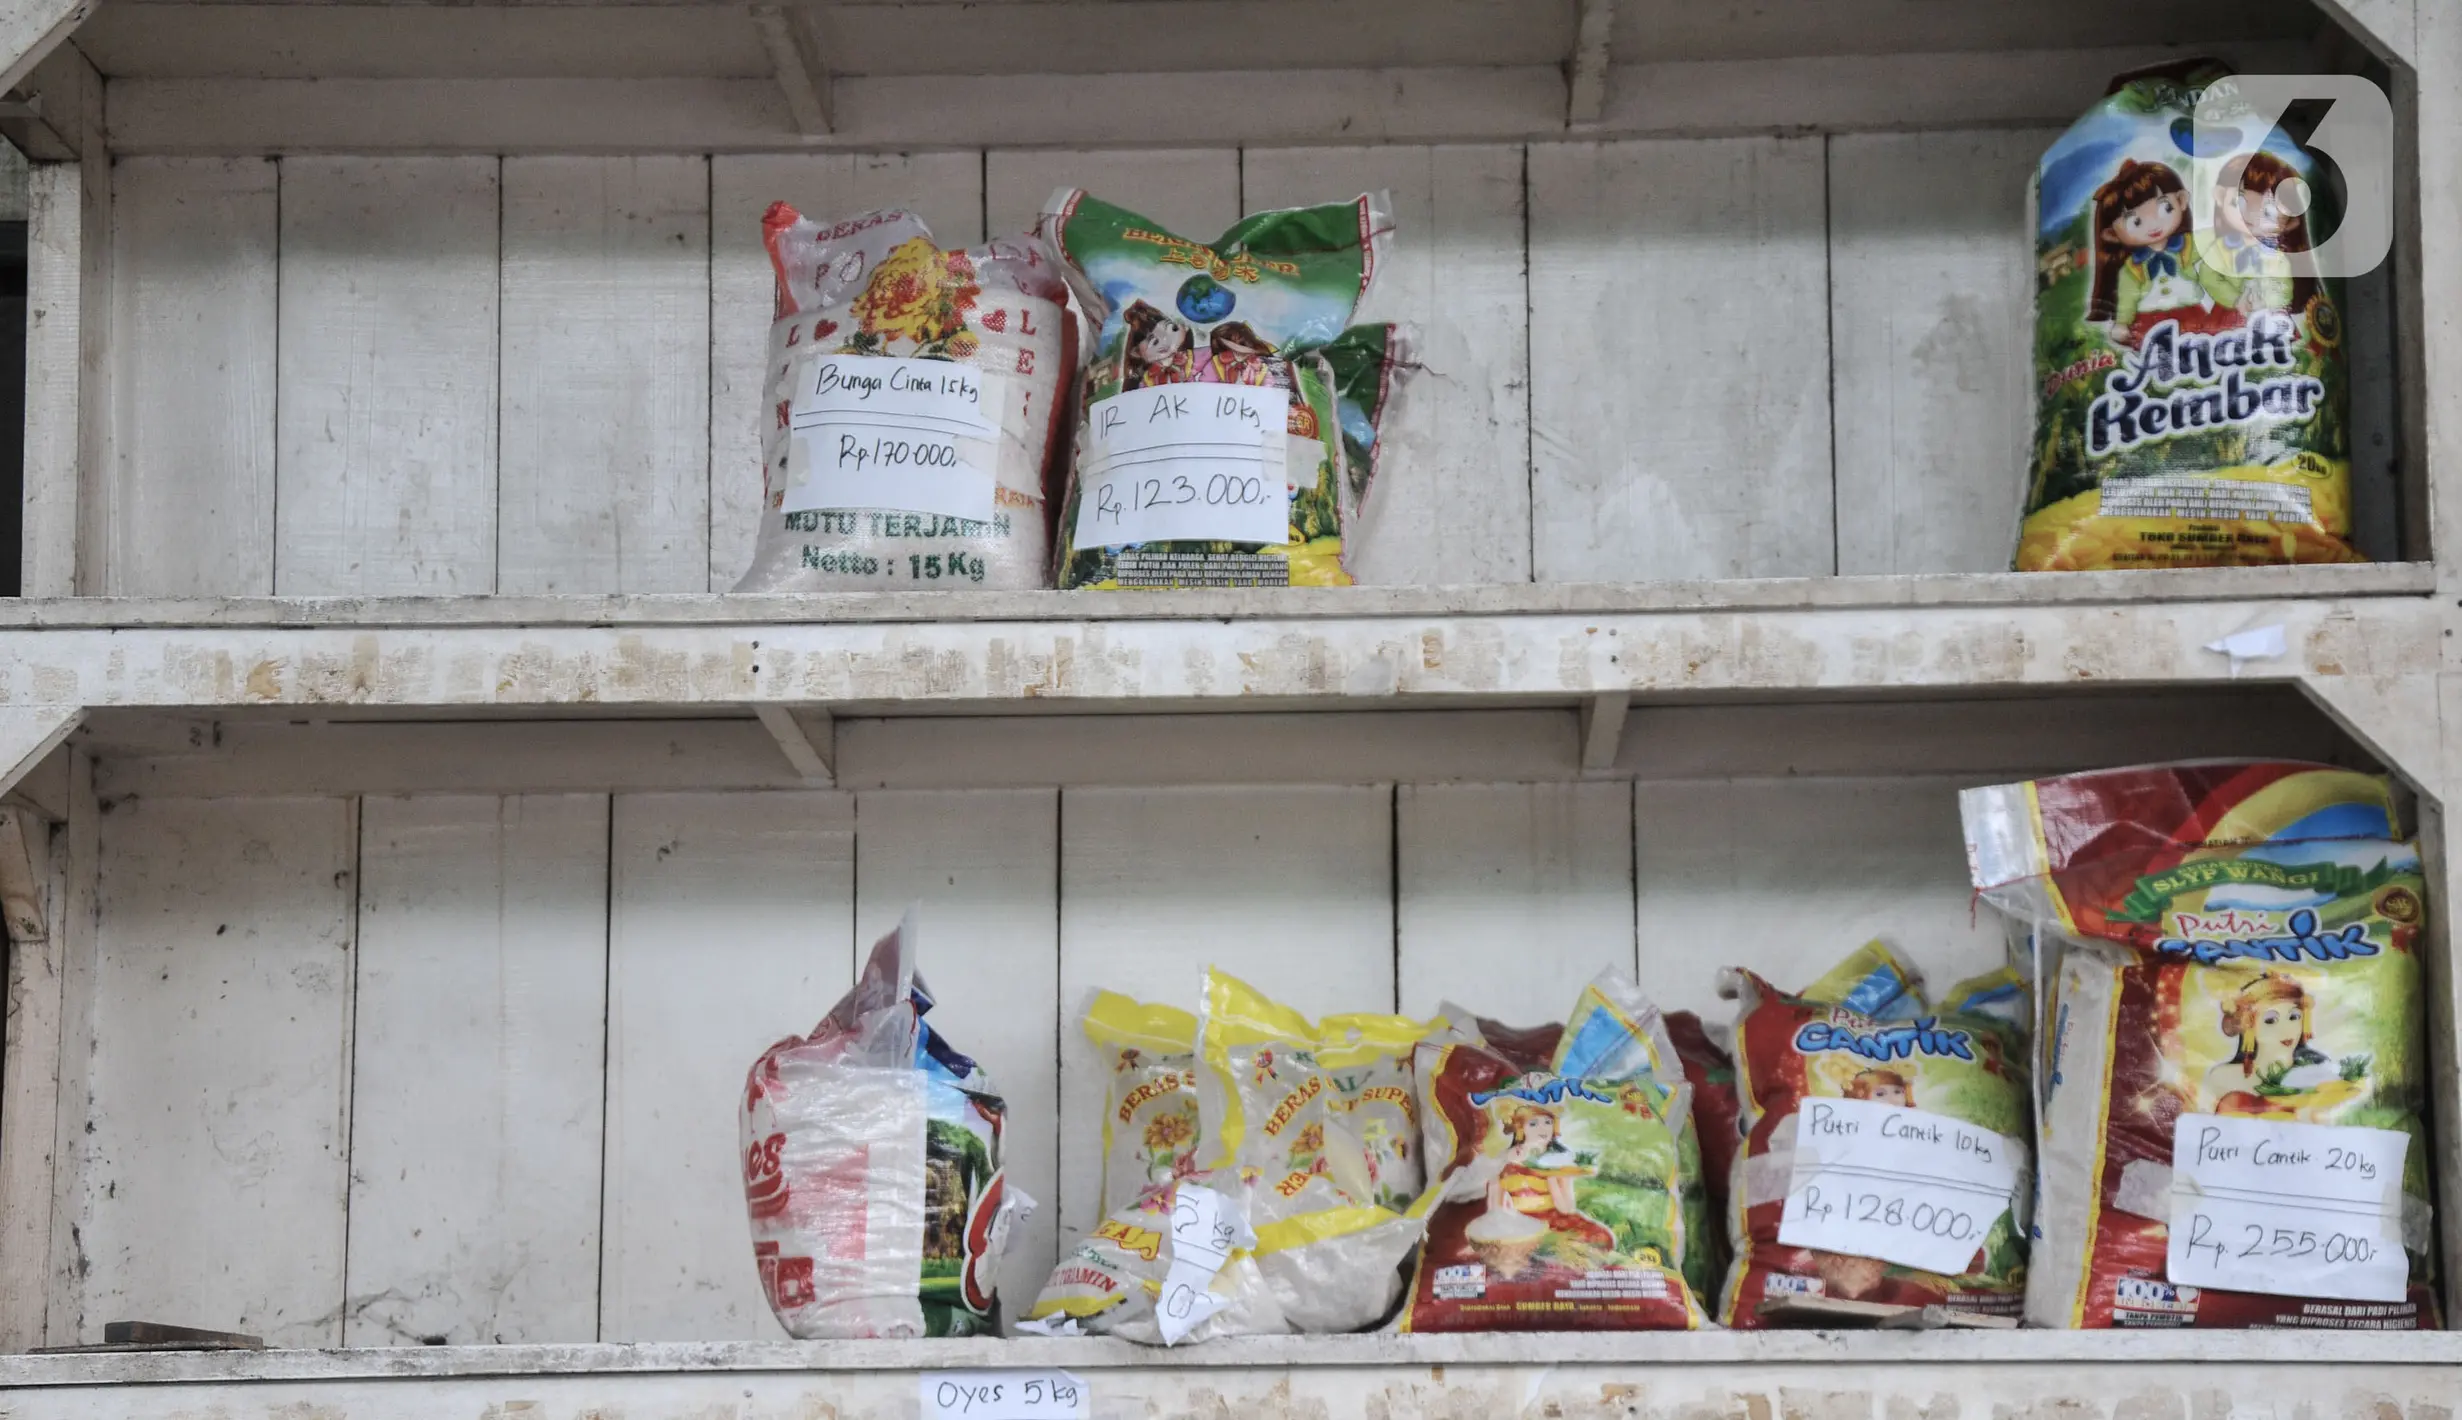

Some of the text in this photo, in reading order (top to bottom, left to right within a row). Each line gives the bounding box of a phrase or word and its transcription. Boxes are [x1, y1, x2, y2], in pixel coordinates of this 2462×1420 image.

[2111, 310, 2295, 392] Anak
[816, 363, 978, 402] Bunga Cinta 15kg
[1149, 395, 1190, 424] AK
[1215, 396, 1260, 427] 10kg
[2091, 371, 2322, 452] Kembar
[801, 544, 879, 575] Netto
[2226, 861, 2319, 886] WANGI
[2176, 911, 2273, 937] Putri
[1795, 1015, 1974, 1061] CANTIK
[1119, 1072, 1180, 1124] BERAS
[1264, 1076, 1321, 1136] BERAS
[1810, 1103, 1992, 1164] Putri Cantik 10kg
[2196, 1126, 2240, 1166] Putri
[2253, 1139, 2311, 1168] Cantik
[2303, 1303, 2343, 1316] BERASAL
[2344, 1305, 2366, 1316] DARI
[2367, 1305, 2387, 1316] PADI
[937, 1381, 1004, 1413] Oyes
